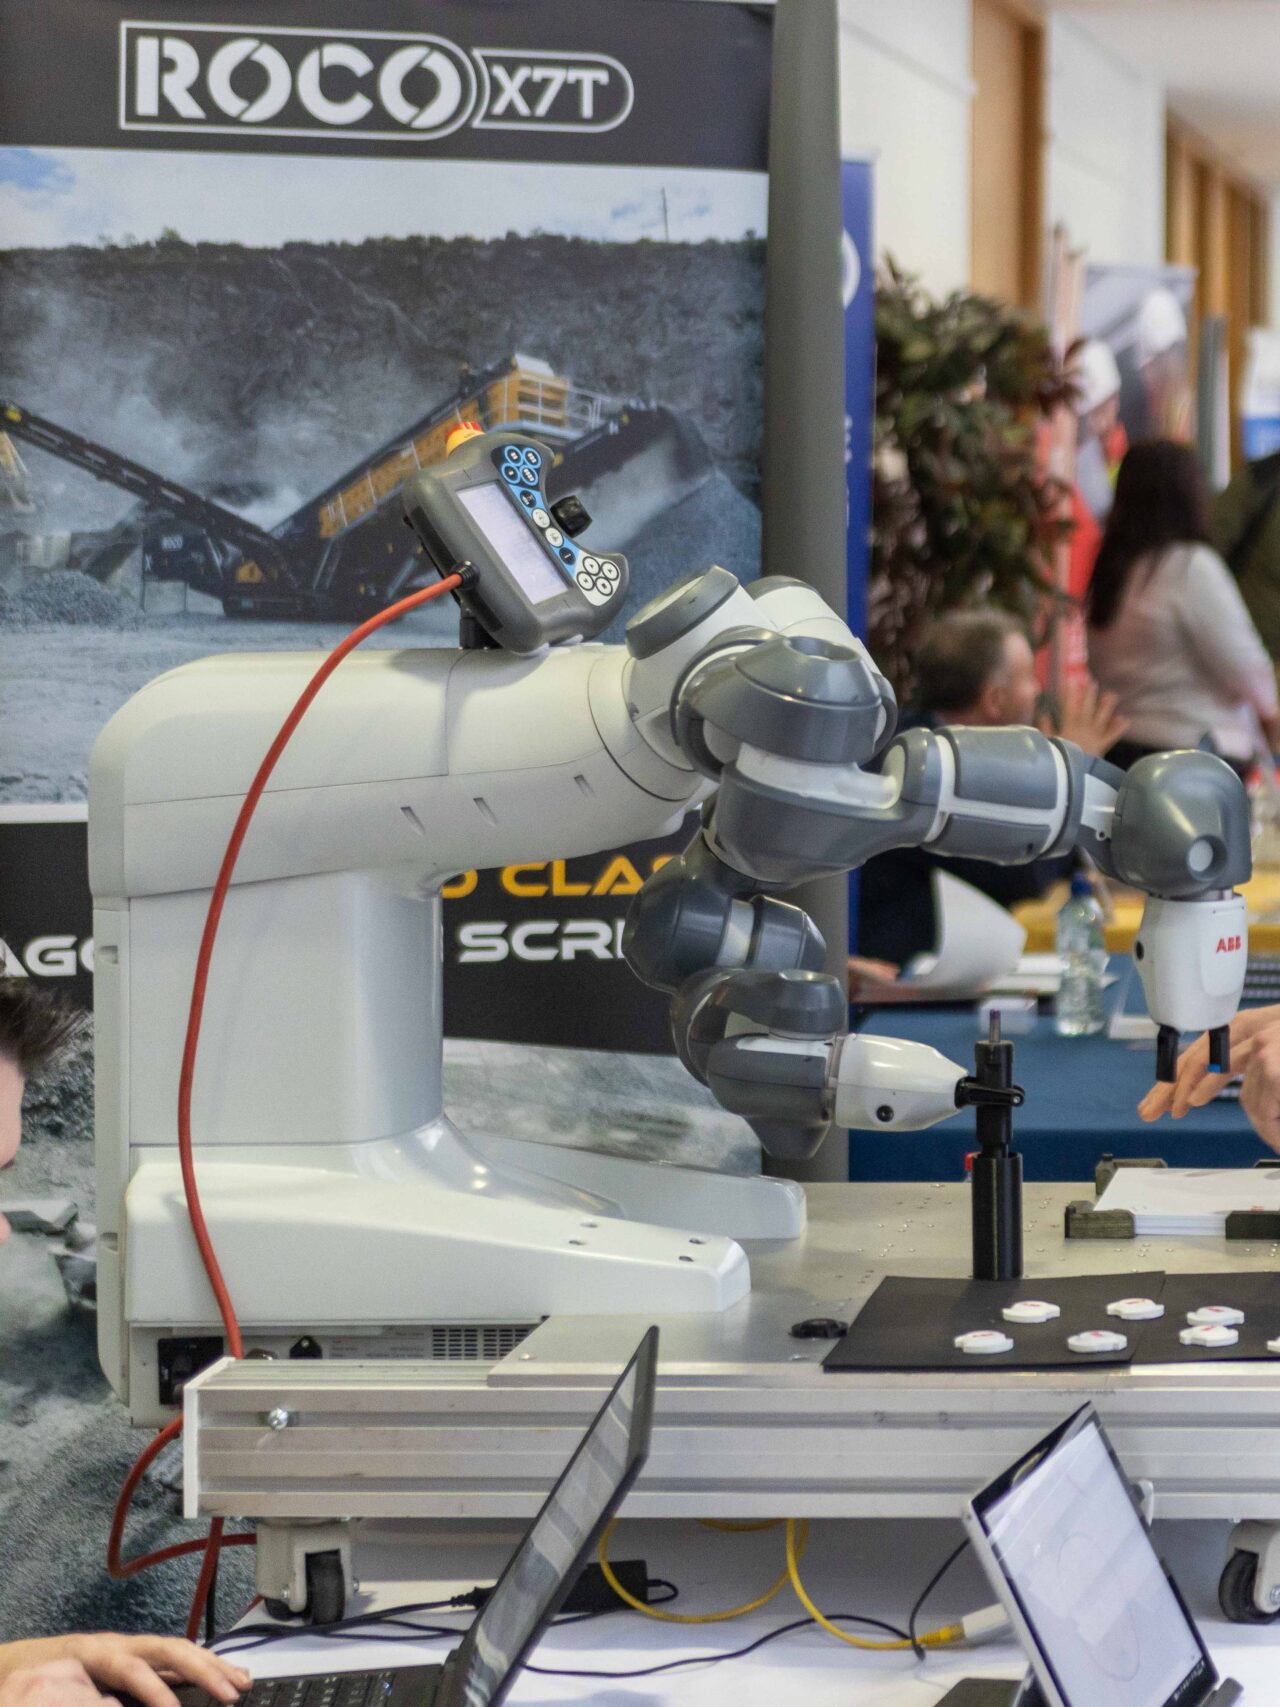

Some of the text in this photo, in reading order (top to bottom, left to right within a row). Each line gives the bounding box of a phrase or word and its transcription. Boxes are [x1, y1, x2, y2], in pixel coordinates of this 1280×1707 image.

[136, 36, 610, 129] ROCO X7T
[501, 854, 673, 898] CLA
[1216, 935, 1242, 953] ABB
